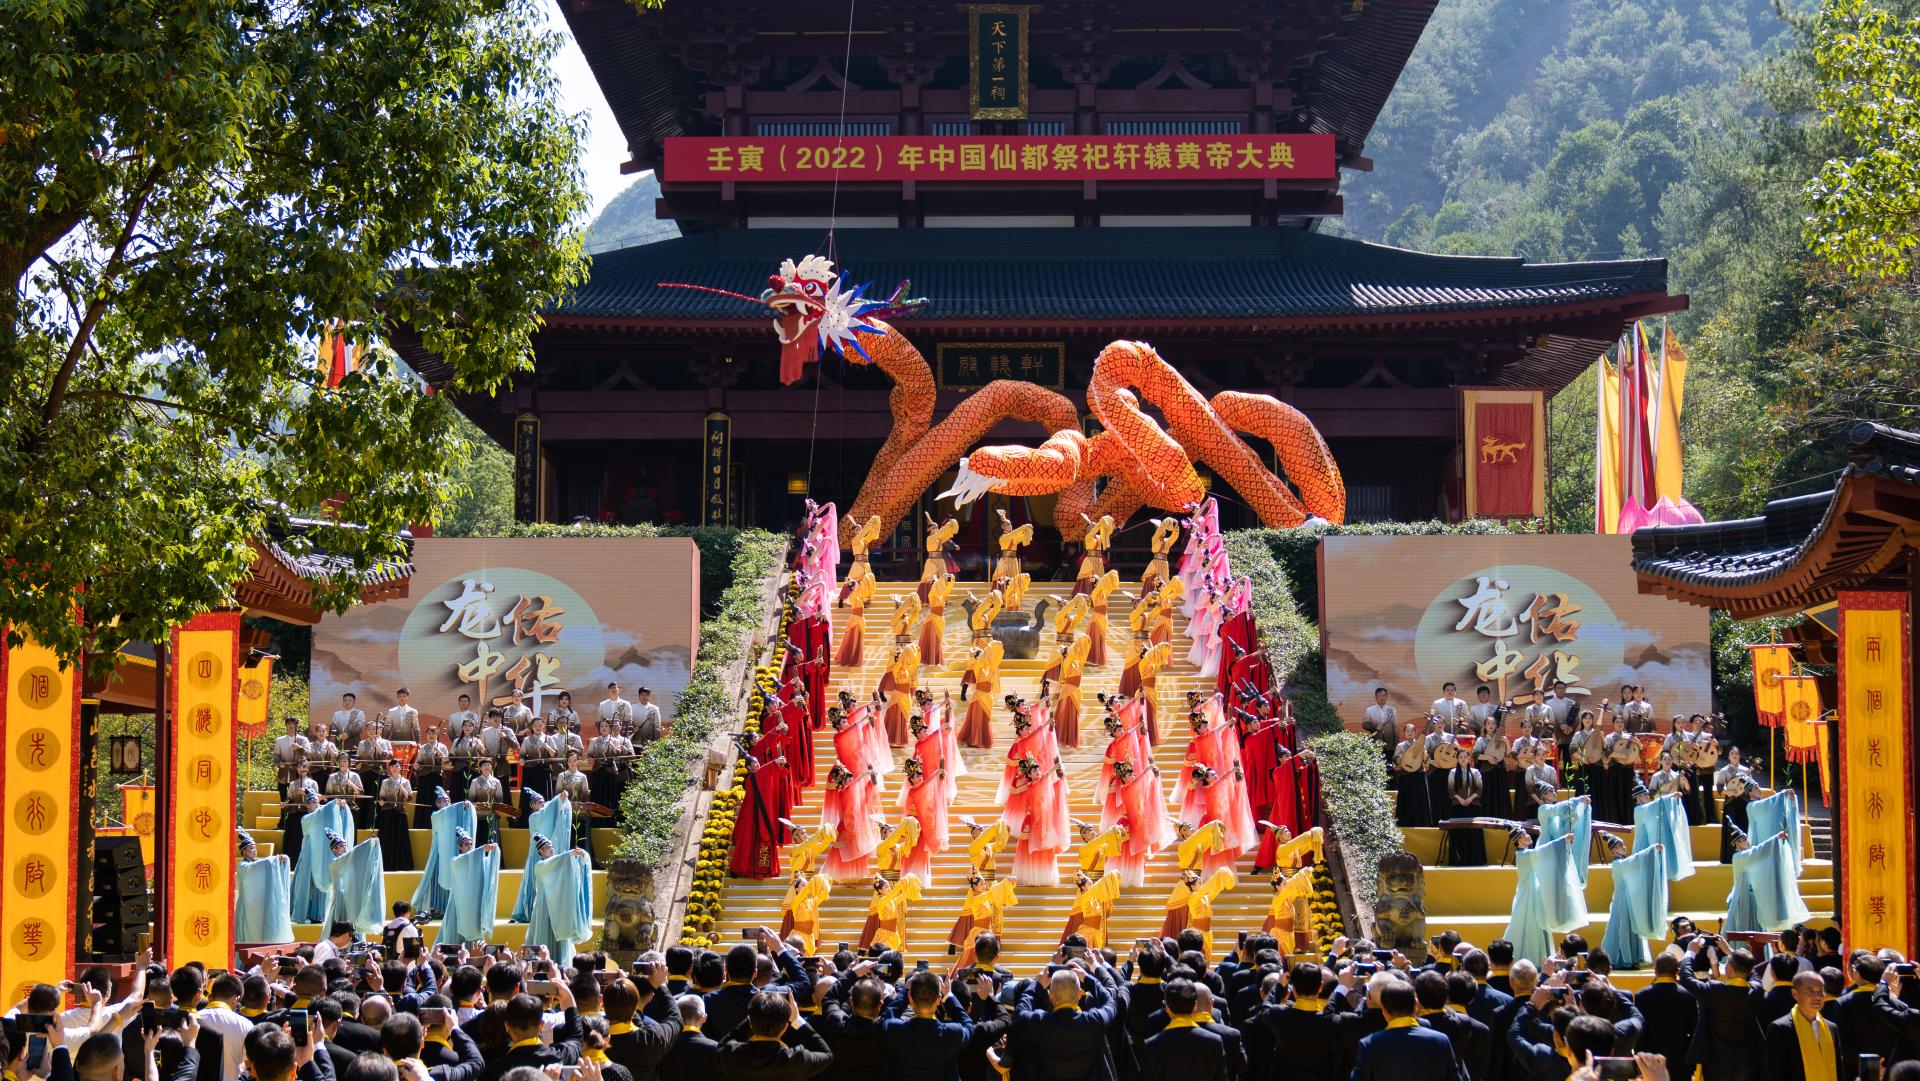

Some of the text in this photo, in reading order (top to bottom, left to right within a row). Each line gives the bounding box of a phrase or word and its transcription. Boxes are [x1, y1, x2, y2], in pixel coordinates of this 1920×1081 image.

[990, 21, 1007, 101] 天下第一祠
[706, 142, 1296, 172] 壬寅（2022）年中国仙都祭祀轩辕黄帝大典
